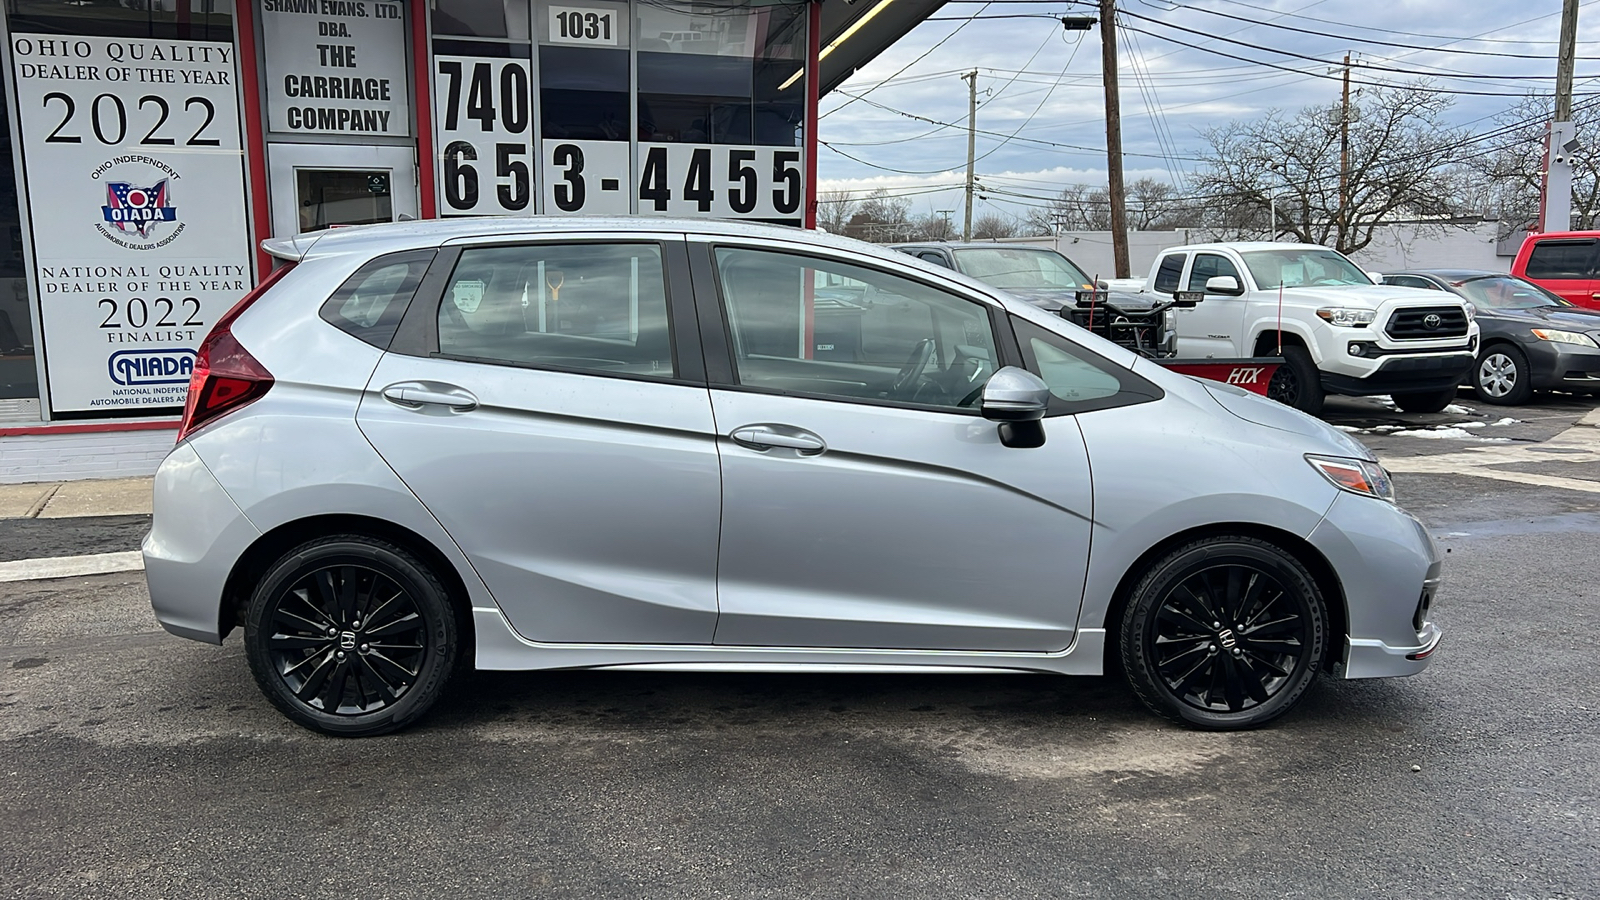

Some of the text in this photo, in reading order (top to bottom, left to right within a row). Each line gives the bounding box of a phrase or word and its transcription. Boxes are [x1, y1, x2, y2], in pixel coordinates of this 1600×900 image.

[264, 0, 318, 14] SHAWN
[374, 3, 402, 19] LTD.
[318, 21, 352, 38] DBA.
[556, 11, 611, 40] 1031
[15, 38, 231, 63] OHIO QUALITY
[316, 44, 357, 68] THE
[20, 63, 231, 85] DEALER OF THE YEAR
[284, 74, 391, 101] CARRIAGE
[438, 61, 529, 134] 740
[42, 91, 221, 146] 2022
[287, 106, 391, 132] COMPANY
[91, 154, 181, 181] OHIO INDEPENDENT
[111, 207, 165, 221] OIADA
[94, 222, 186, 251] AUTOMOBILE DEALERS ASSOCIATION
[42, 265, 245, 279] NATIONAL QUALITY
[46, 280, 244, 293] DEALER OF THE YEAR
[98, 297, 204, 328] 2022
[107, 330, 196, 343] FINALIST
[116, 356, 194, 376] NIADA
[1226, 367, 1265, 384] HTX
[90, 397, 140, 406] AUTOMOBILE
[142, 396, 175, 404] DEALERS
[112, 387, 151, 396] NATIONAL
